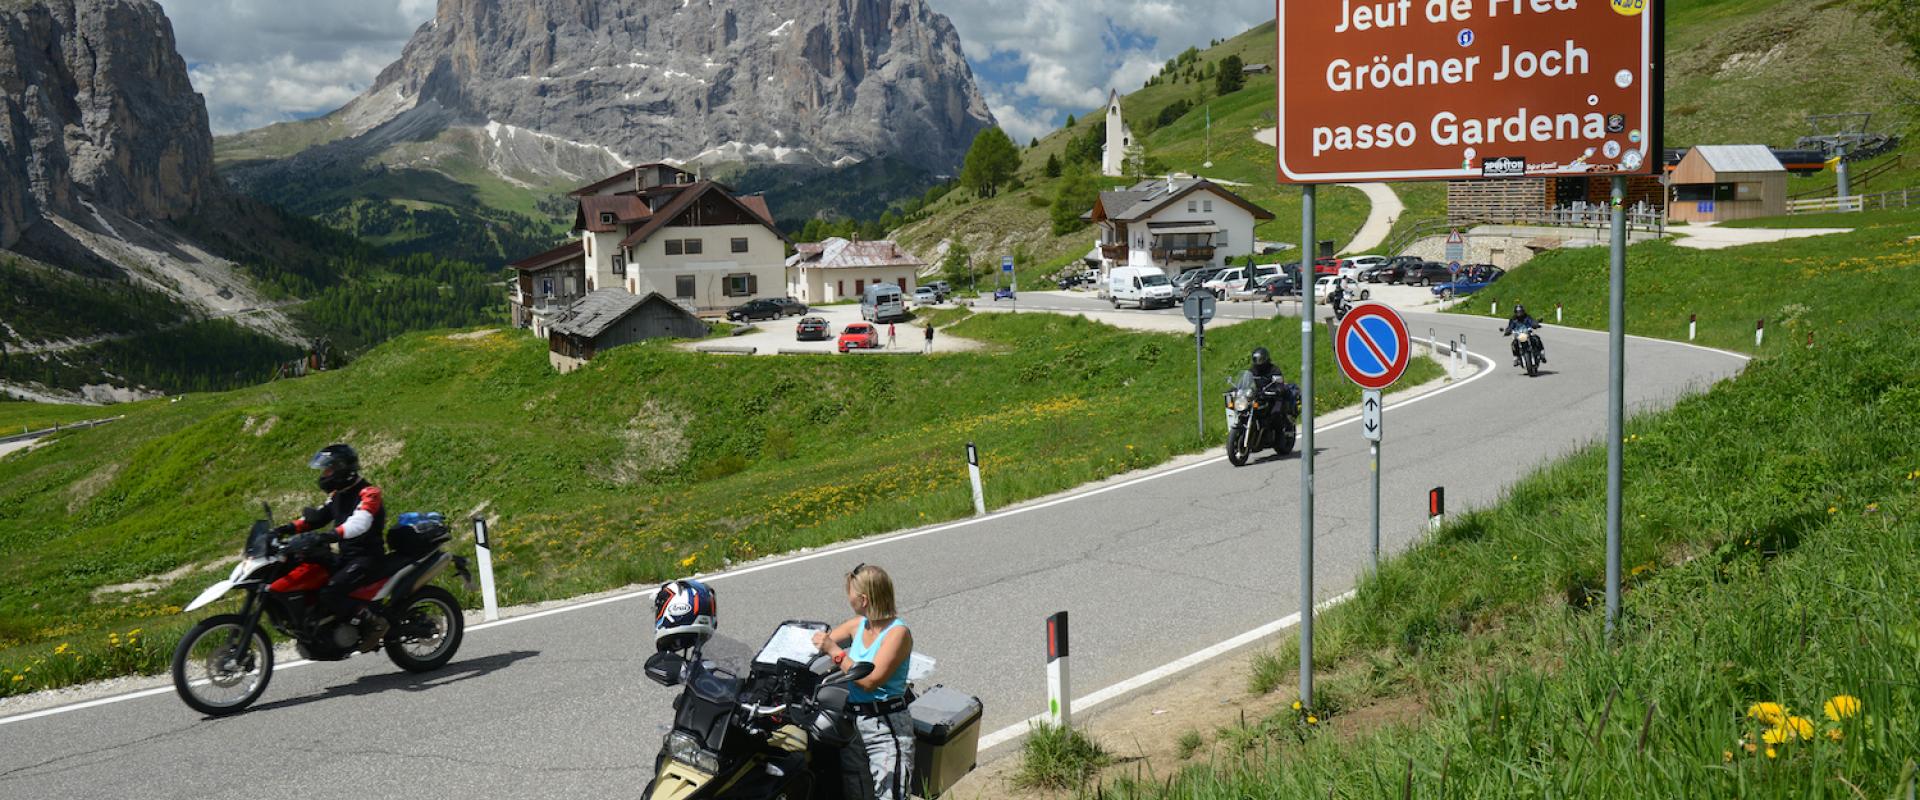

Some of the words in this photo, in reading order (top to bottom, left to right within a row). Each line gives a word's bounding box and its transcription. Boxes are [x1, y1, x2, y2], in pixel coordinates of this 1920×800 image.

[1334, 0, 1412, 33] Jeuf
[1425, 0, 1473, 23] de
[1325, 53, 1481, 92] Grödner
[1493, 39, 1589, 81] Joch
[1312, 121, 1417, 157] passo
[1430, 107, 1606, 146] Gardena
